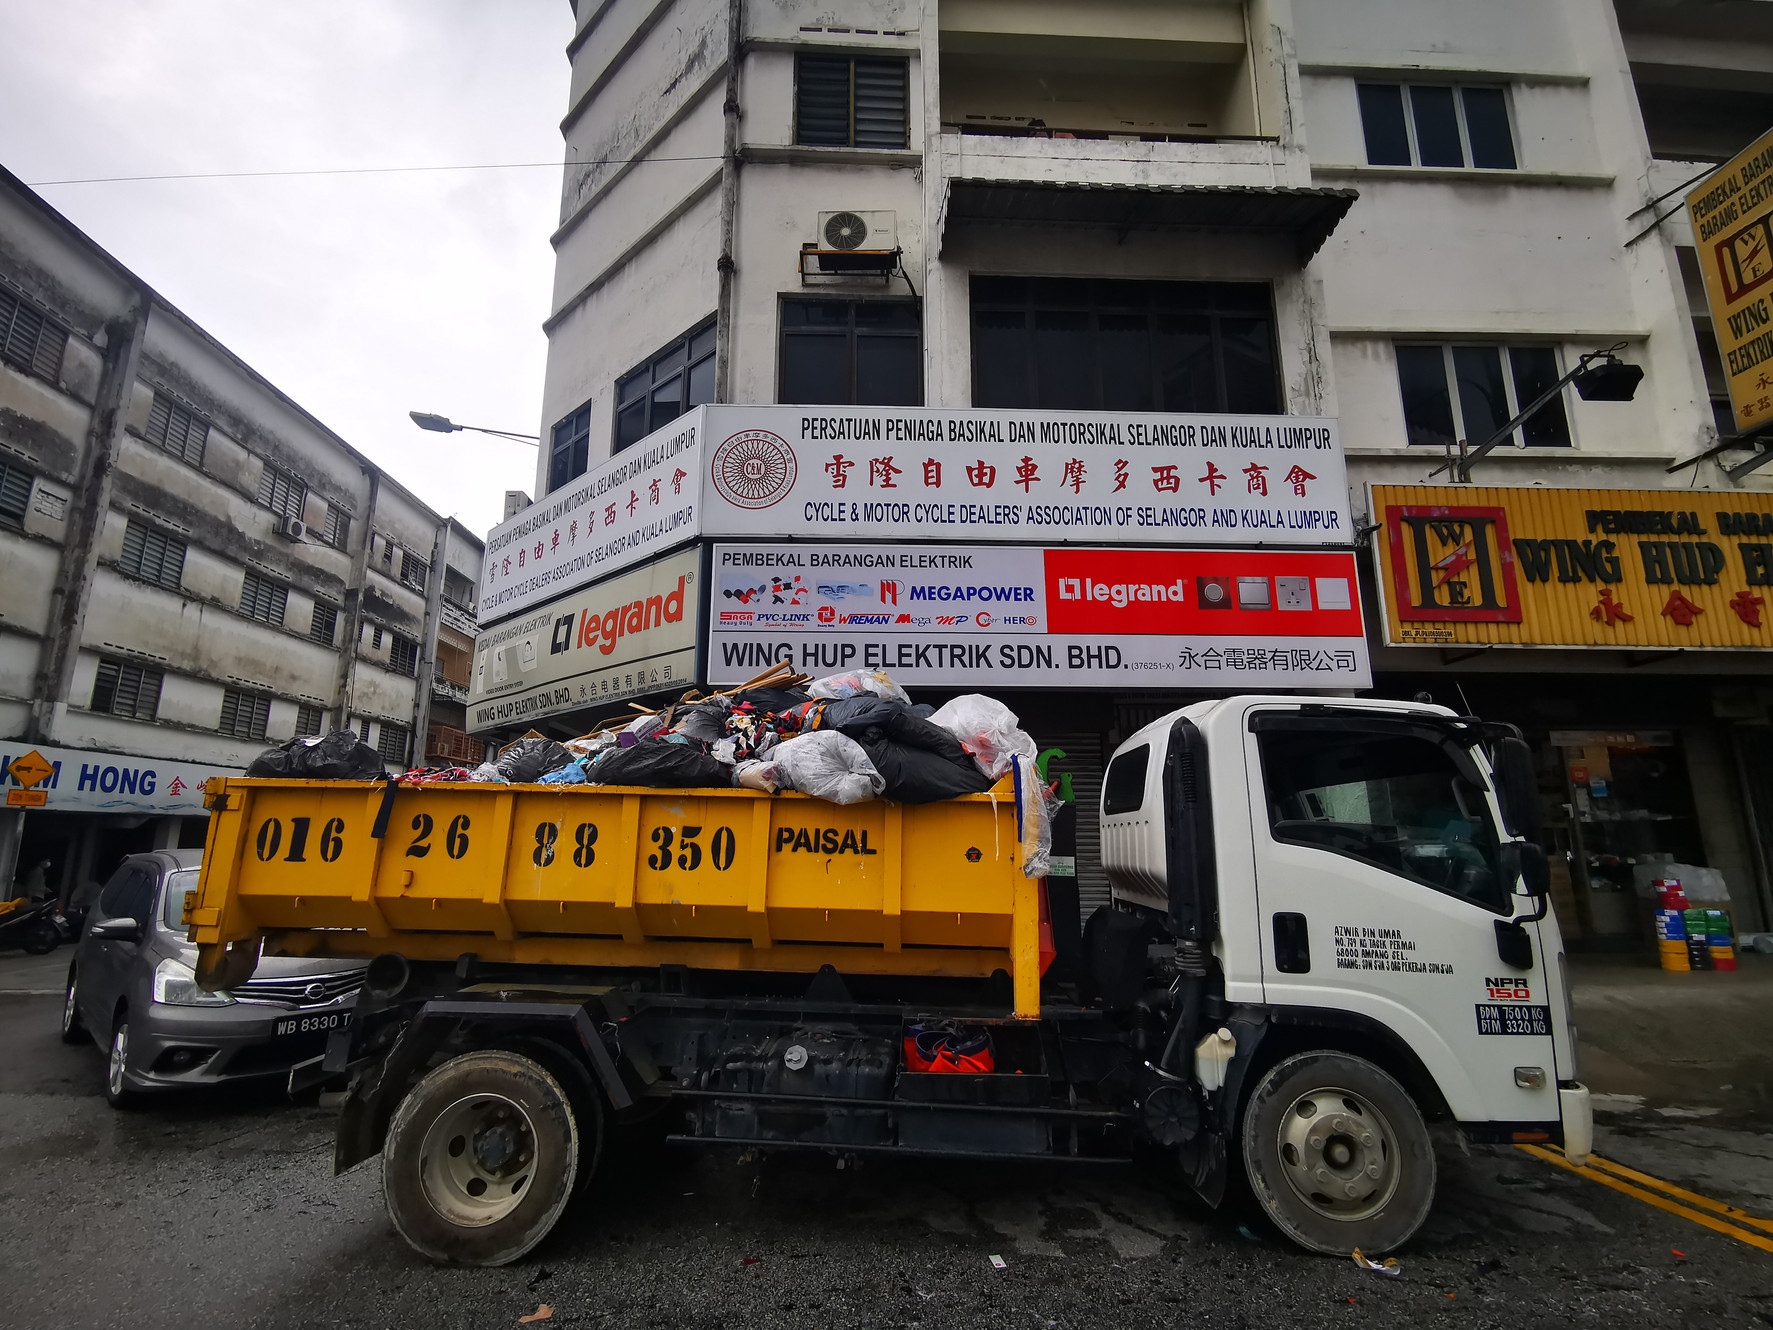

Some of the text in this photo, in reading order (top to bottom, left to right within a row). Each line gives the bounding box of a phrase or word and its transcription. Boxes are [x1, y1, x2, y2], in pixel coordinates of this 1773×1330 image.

[1692, 174, 1741, 223] PEMBEKAL
[1700, 201, 1739, 242] BARANG
[1727, 298, 1771, 341] WING
[801, 417, 1332, 450] PERSATUAN PENIAGA BASIKAL DAN MOTORSIKAL SELANGOR DAN KUALA LUMPUR
[532, 508, 551, 532] BASIKAL
[552, 503, 563, 521] DAN
[563, 483, 596, 514] MOTORSIKAL
[597, 465, 628, 496] SELANGOR
[629, 457, 642, 480] DAN
[643, 444, 665, 472] KUALA
[666, 427, 696, 458] LUMPUR
[824, 454, 1318, 498] 雪隆自由車摩多西卡商會
[804, 501, 1340, 530] CYCLE & MOTOR CYCLE DEALERS' ASSOCIATION OF SELANGOR AND KUALA LUMPUR
[1585, 510, 1708, 535] PEMBEKAL
[551, 555, 586, 582] ASSOCIATION
[586, 549, 594, 568] OF
[595, 536, 626, 563] SELANGOR
[627, 530, 640, 550] AND
[641, 516, 664, 544] KUALA
[665, 505, 693, 533] LUMPUR
[722, 553, 973, 569] PEMBEKAL BARANGAN ELEKTRIK
[1512, 538, 1622, 584] WING
[1637, 540, 1726, 586] HUP
[910, 585, 1035, 602] MEGAPOWER
[1086, 578, 1184, 608] legrand
[523, 612, 554, 634] ELEKTRIK
[576, 575, 686, 655] legrand
[757, 613, 811, 622] PVC-LINK
[839, 613, 892, 625] WIREMAN
[894, 613, 932, 628] Mega
[1003, 616, 1037, 626] HERO
[722, 642, 1175, 671] WING HUP ELEKTRIK SDN. BHD. (376251-X)
[1179, 647, 1357, 672] 永合電器有限公司
[580, 665, 672, 699] 永合电器有限公司
[476, 686, 572, 723] WING HUP ELEKTRIK SDN. BHD.
[0, 755, 157, 796] KM HONG
[256, 817, 345, 863] 016
[406, 813, 471, 860] 26
[532, 822, 599, 868] 88
[647, 826, 736, 872] 350
[775, 827, 878, 855] PAISAL
[1334, 926, 1402, 940] AZWIR BIN UMAR
[1368, 939, 1387, 949] TASEK
[1389, 940, 1416, 951] PERMAI
[1336, 948, 1408, 960] 68000 AMPANG SEL.
[1485, 977, 1529, 988] NPR
[1486, 988, 1530, 998] 150
[277, 1020, 297, 1036] WB
[300, 1015, 338, 1033] 8330
[1480, 1006, 1544, 1020] BDM 7500 KG
[1481, 1020, 1546, 1033] BTM 3320 KG
